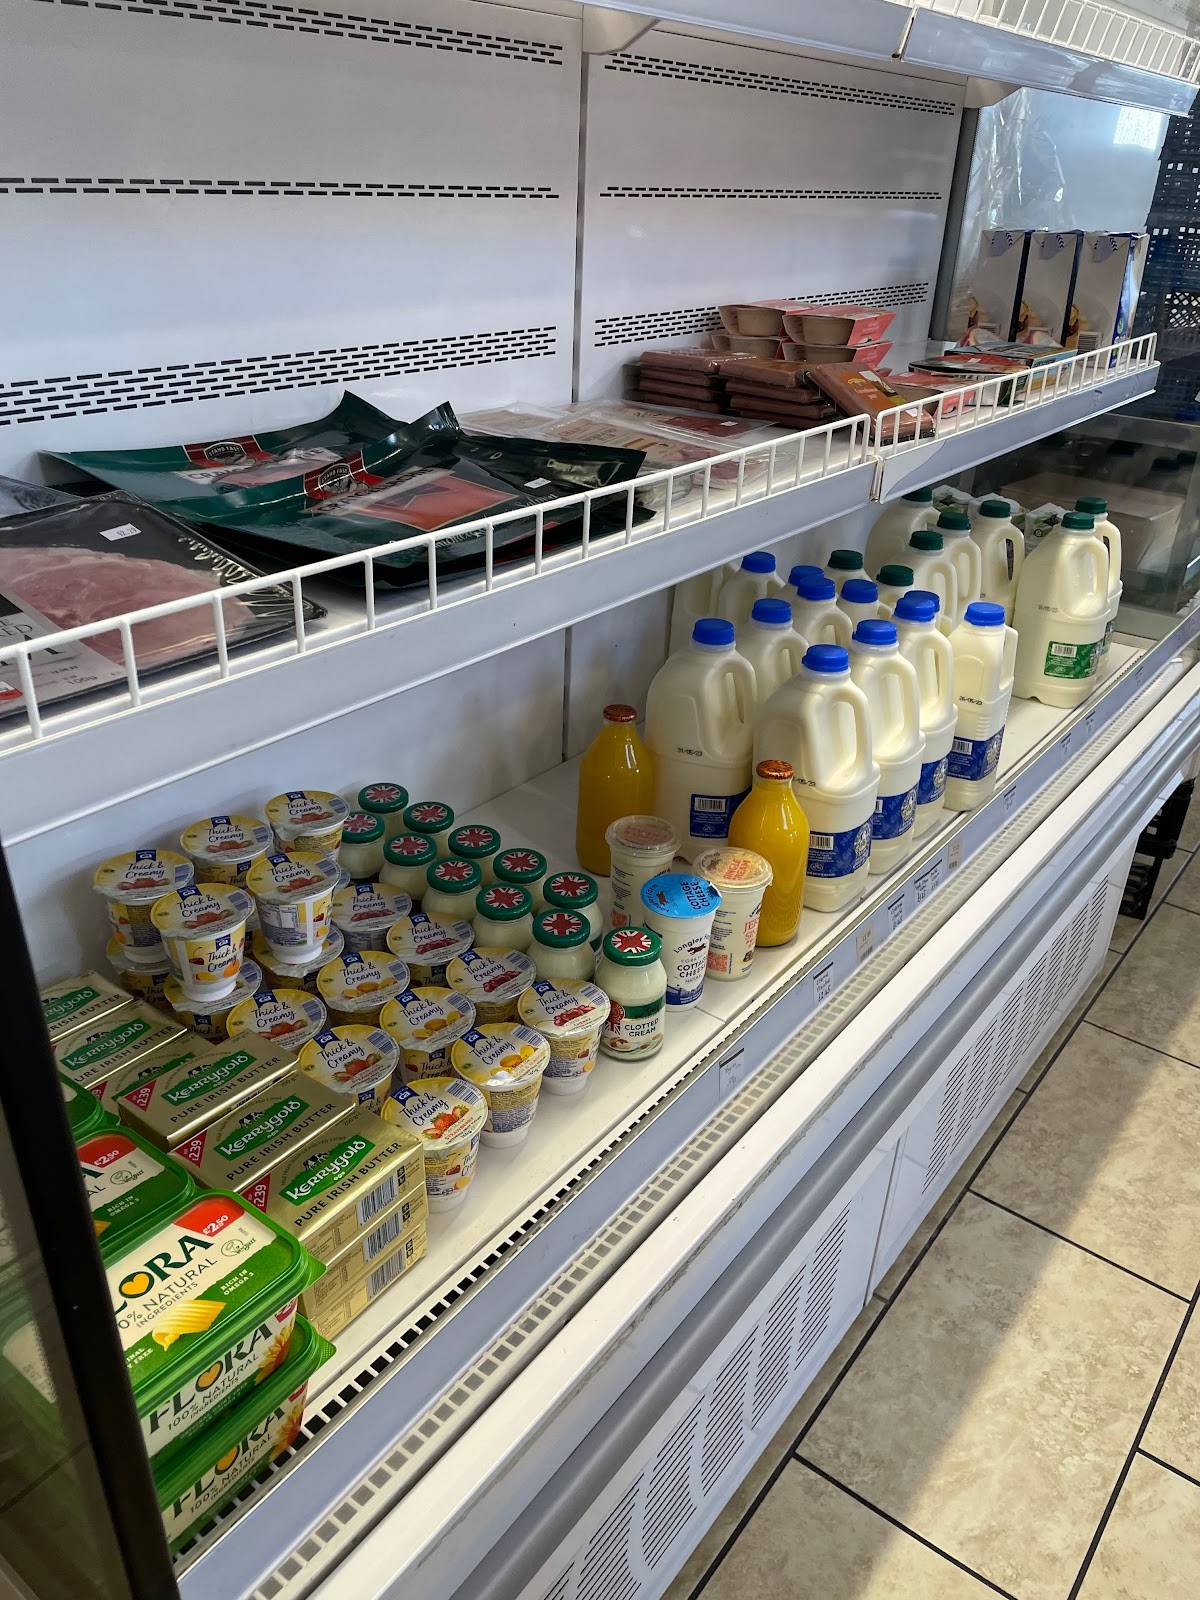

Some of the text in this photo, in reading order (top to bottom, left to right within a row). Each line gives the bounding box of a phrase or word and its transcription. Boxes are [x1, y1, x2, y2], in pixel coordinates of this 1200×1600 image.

[125, 868, 166, 879] Creamy
[177, 897, 204, 910] Thick
[681, 880, 702, 911] COTTAGE
[690, 880, 711, 907] CHEESE
[181, 901, 222, 918] Creamy
[207, 955, 237, 973] Creamy
[339, 962, 368, 977] Thick
[345, 969, 382, 986] Creamy
[79, 993, 122, 1016] BUTTER
[400, 1001, 425, 1018] Thick
[536, 992, 562, 1007] Thick
[545, 996, 579, 1015] Creamy
[251, 1004, 280, 1019] Thick
[256, 1010, 296, 1028] Creamy
[408, 1005, 444, 1026] Creamy
[624, 1017, 659, 1031] CLOTTED
[628, 1026, 656, 1038] CREAM
[74, 1025, 175, 1083] URE IRISH BUTTER
[317, 1040, 346, 1060] Thick
[327, 1045, 365, 1069] Creamy
[469, 1038, 495, 1058] Thick
[481, 1040, 516, 1065] Creamy
[170, 1055, 281, 1123] PURE IRISH BUTTER
[400, 1095, 427, 1119] Thick
[412, 1099, 450, 1127] Creamy
[227, 1154, 260, 1181] PURE
[259, 1132, 294, 1157] IRISH
[293, 1102, 338, 1134] BUTTER
[293, 1199, 329, 1228] PURE
[327, 1175, 360, 1201] IRISH
[358, 1140, 402, 1176] BUTTER
[219, 1268, 249, 1291] RICH IN
[223, 1276, 250, 1296] OMEGA
[118, 1257, 218, 1330] 0% NATURAL
[136, 1280, 198, 1329] INGREDIENTS
[149, 1323, 273, 1435] FLORA
[167, 1402, 200, 1431] 100%
[202, 1353, 259, 1405] NATURAL
[190, 1377, 240, 1420] INGREDIENTS
[190, 1433, 273, 1514] 100% NATURAL
